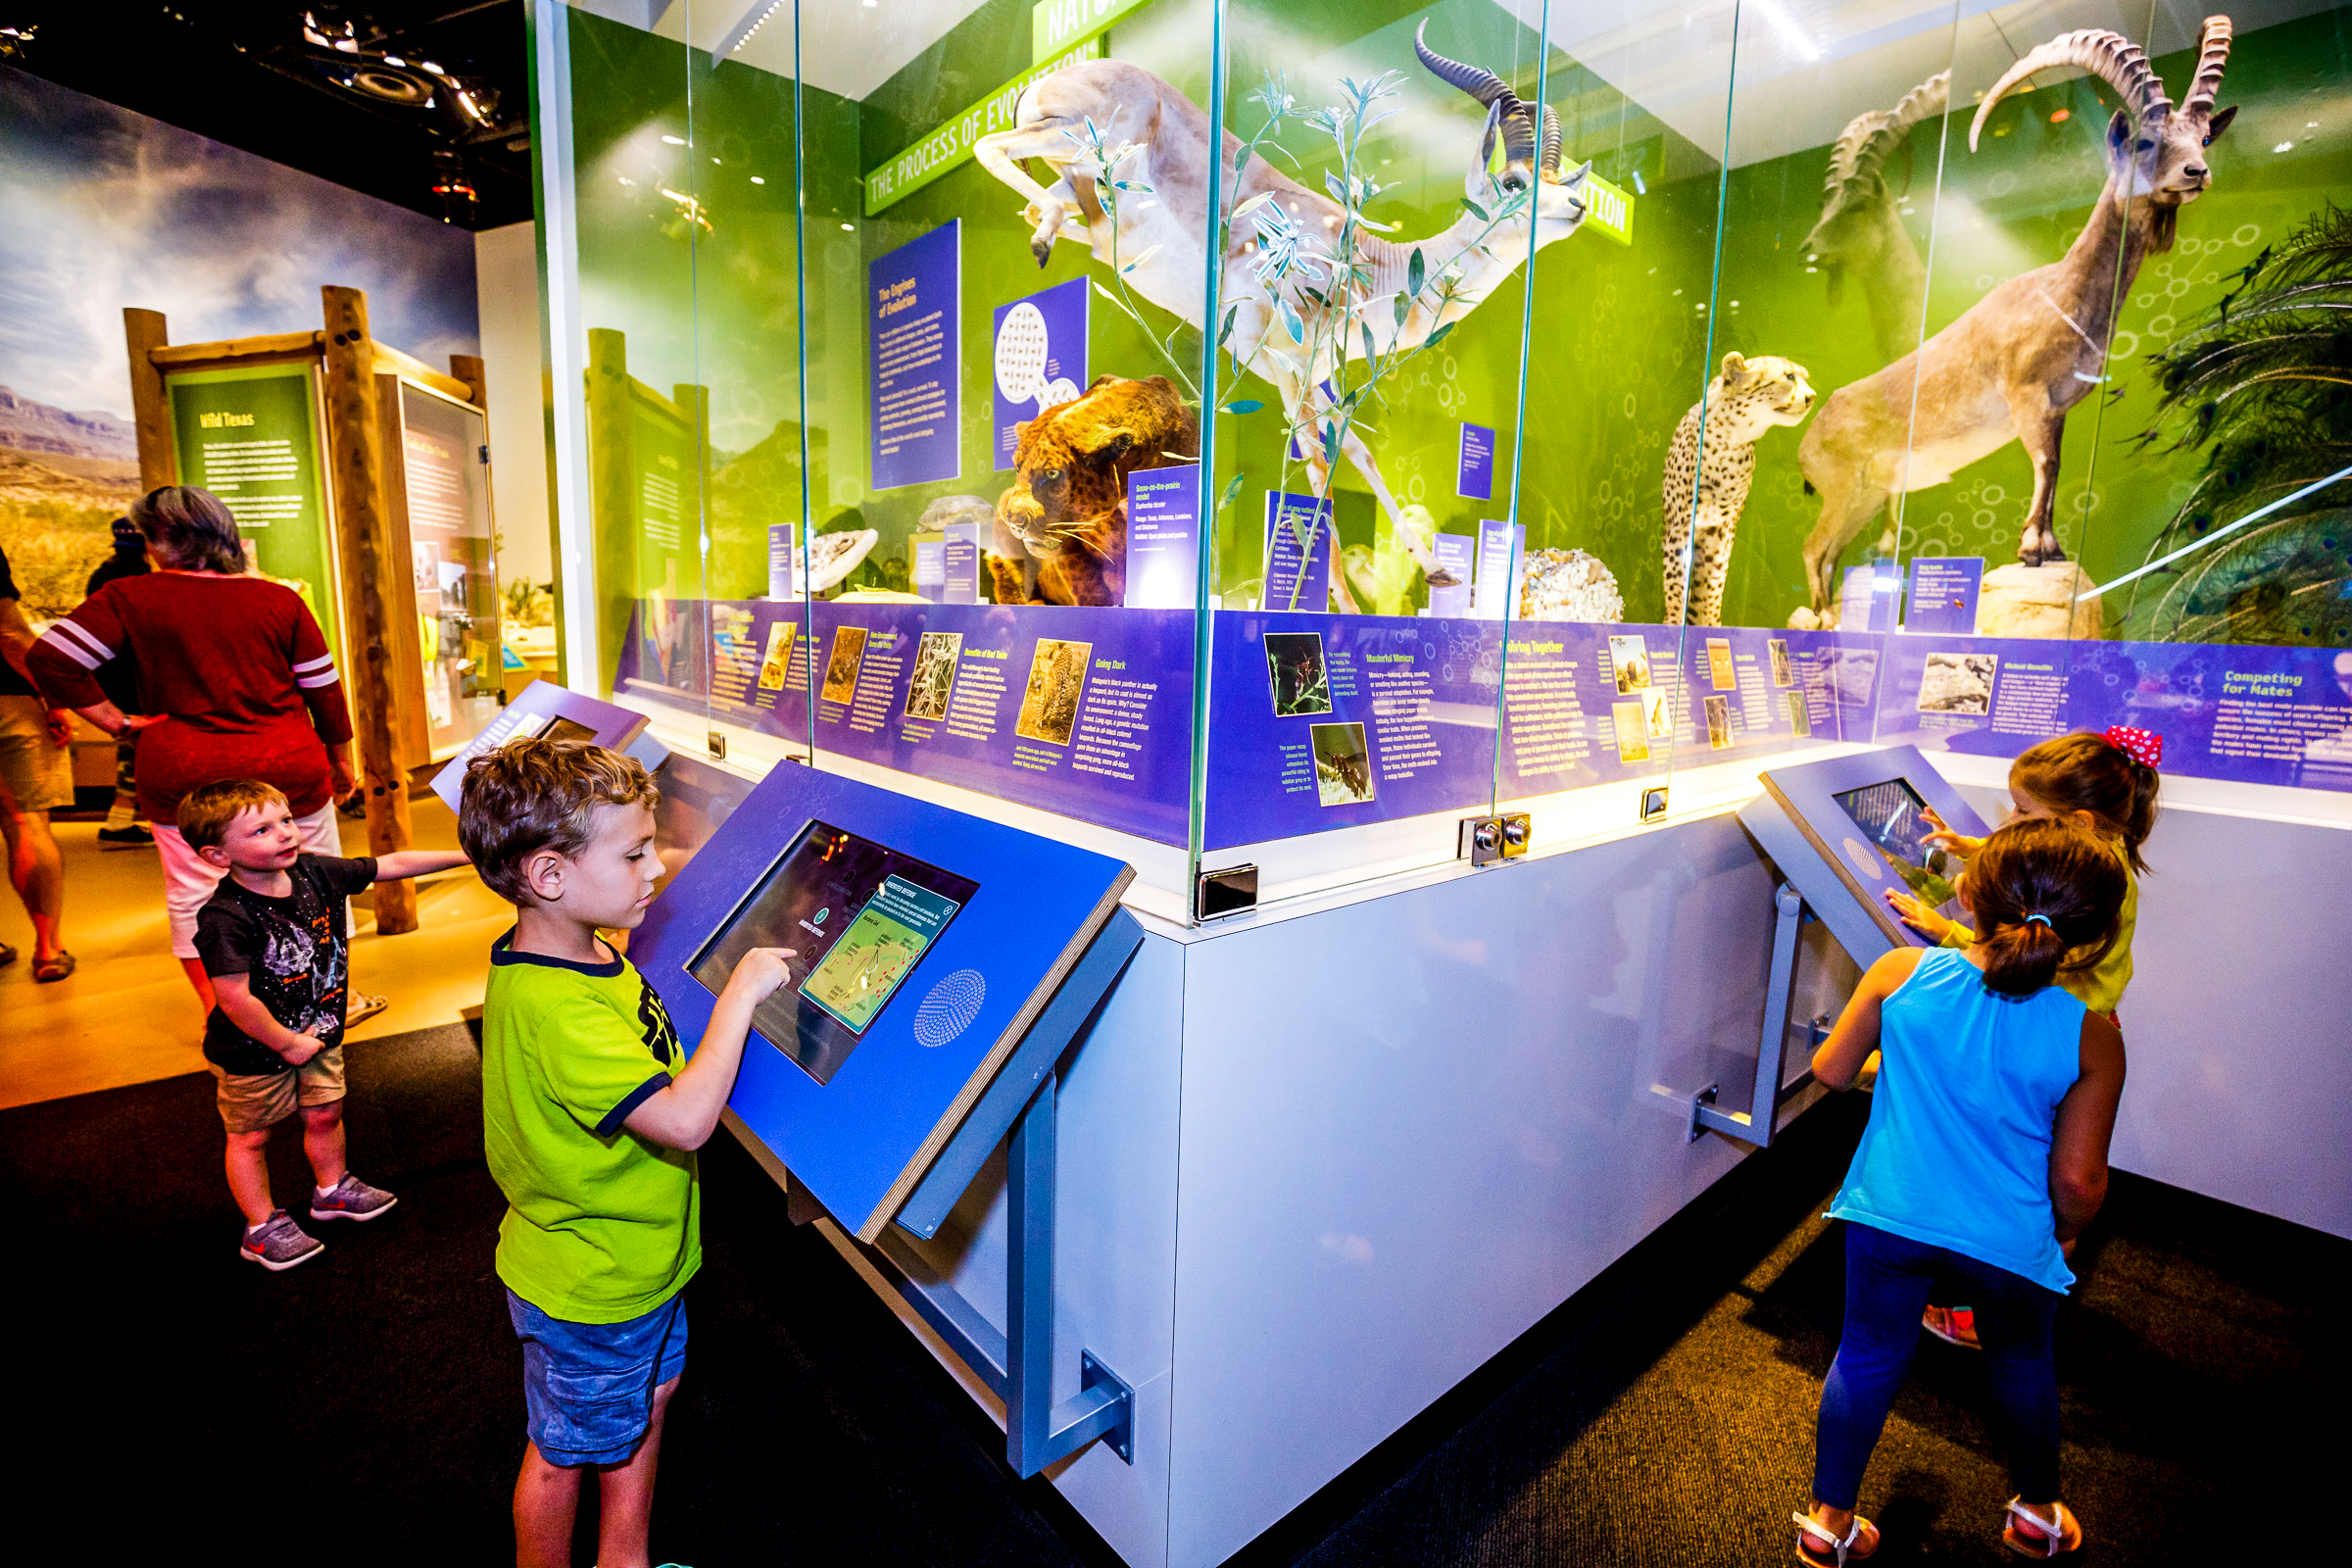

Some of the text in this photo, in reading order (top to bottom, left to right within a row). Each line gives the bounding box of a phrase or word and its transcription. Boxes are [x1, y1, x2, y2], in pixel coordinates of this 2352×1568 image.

[871, 43, 1088, 202] THE PROCESS OF EVOION
[878, 277, 916, 302] The Engines
[878, 294, 916, 319] of Evolution
[200, 412, 255, 428] Wild Texas
[1531, 640, 1564, 656] Together
[1096, 659, 1126, 670] Going Dark
[1366, 654, 1414, 663] Masterful Mimicry
[2225, 670, 2303, 686] Competing
[2223, 683, 2293, 697] for Mates
[2219, 699, 2244, 708] Finding
